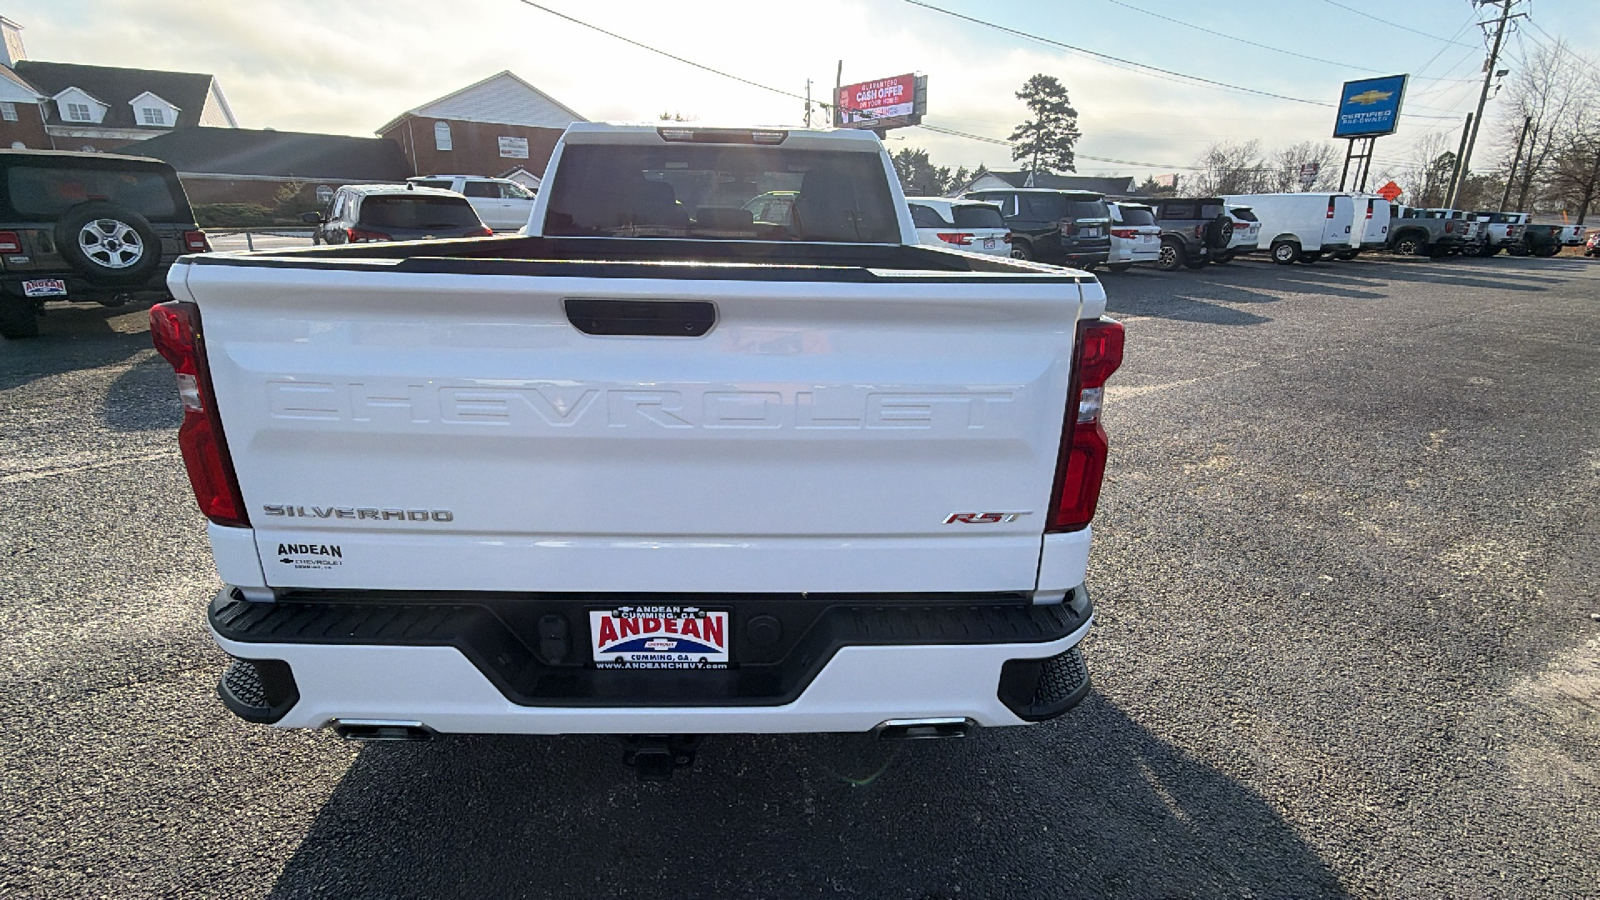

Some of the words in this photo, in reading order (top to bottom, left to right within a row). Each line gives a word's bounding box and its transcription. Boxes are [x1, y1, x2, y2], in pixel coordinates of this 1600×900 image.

[856, 90, 877, 102] CASH
[878, 85, 903, 98] OFFER
[868, 99, 882, 107] YOUR
[1341, 110, 1391, 120] CERTIFIED
[1342, 116, 1387, 124] PRE-OWNED
[265, 379, 1014, 429] CHEVROLET
[263, 504, 454, 523] SILVERADO
[941, 511, 1034, 524] RST
[277, 543, 343, 559] ANDEAN
[598, 615, 724, 649] ANDEAN
